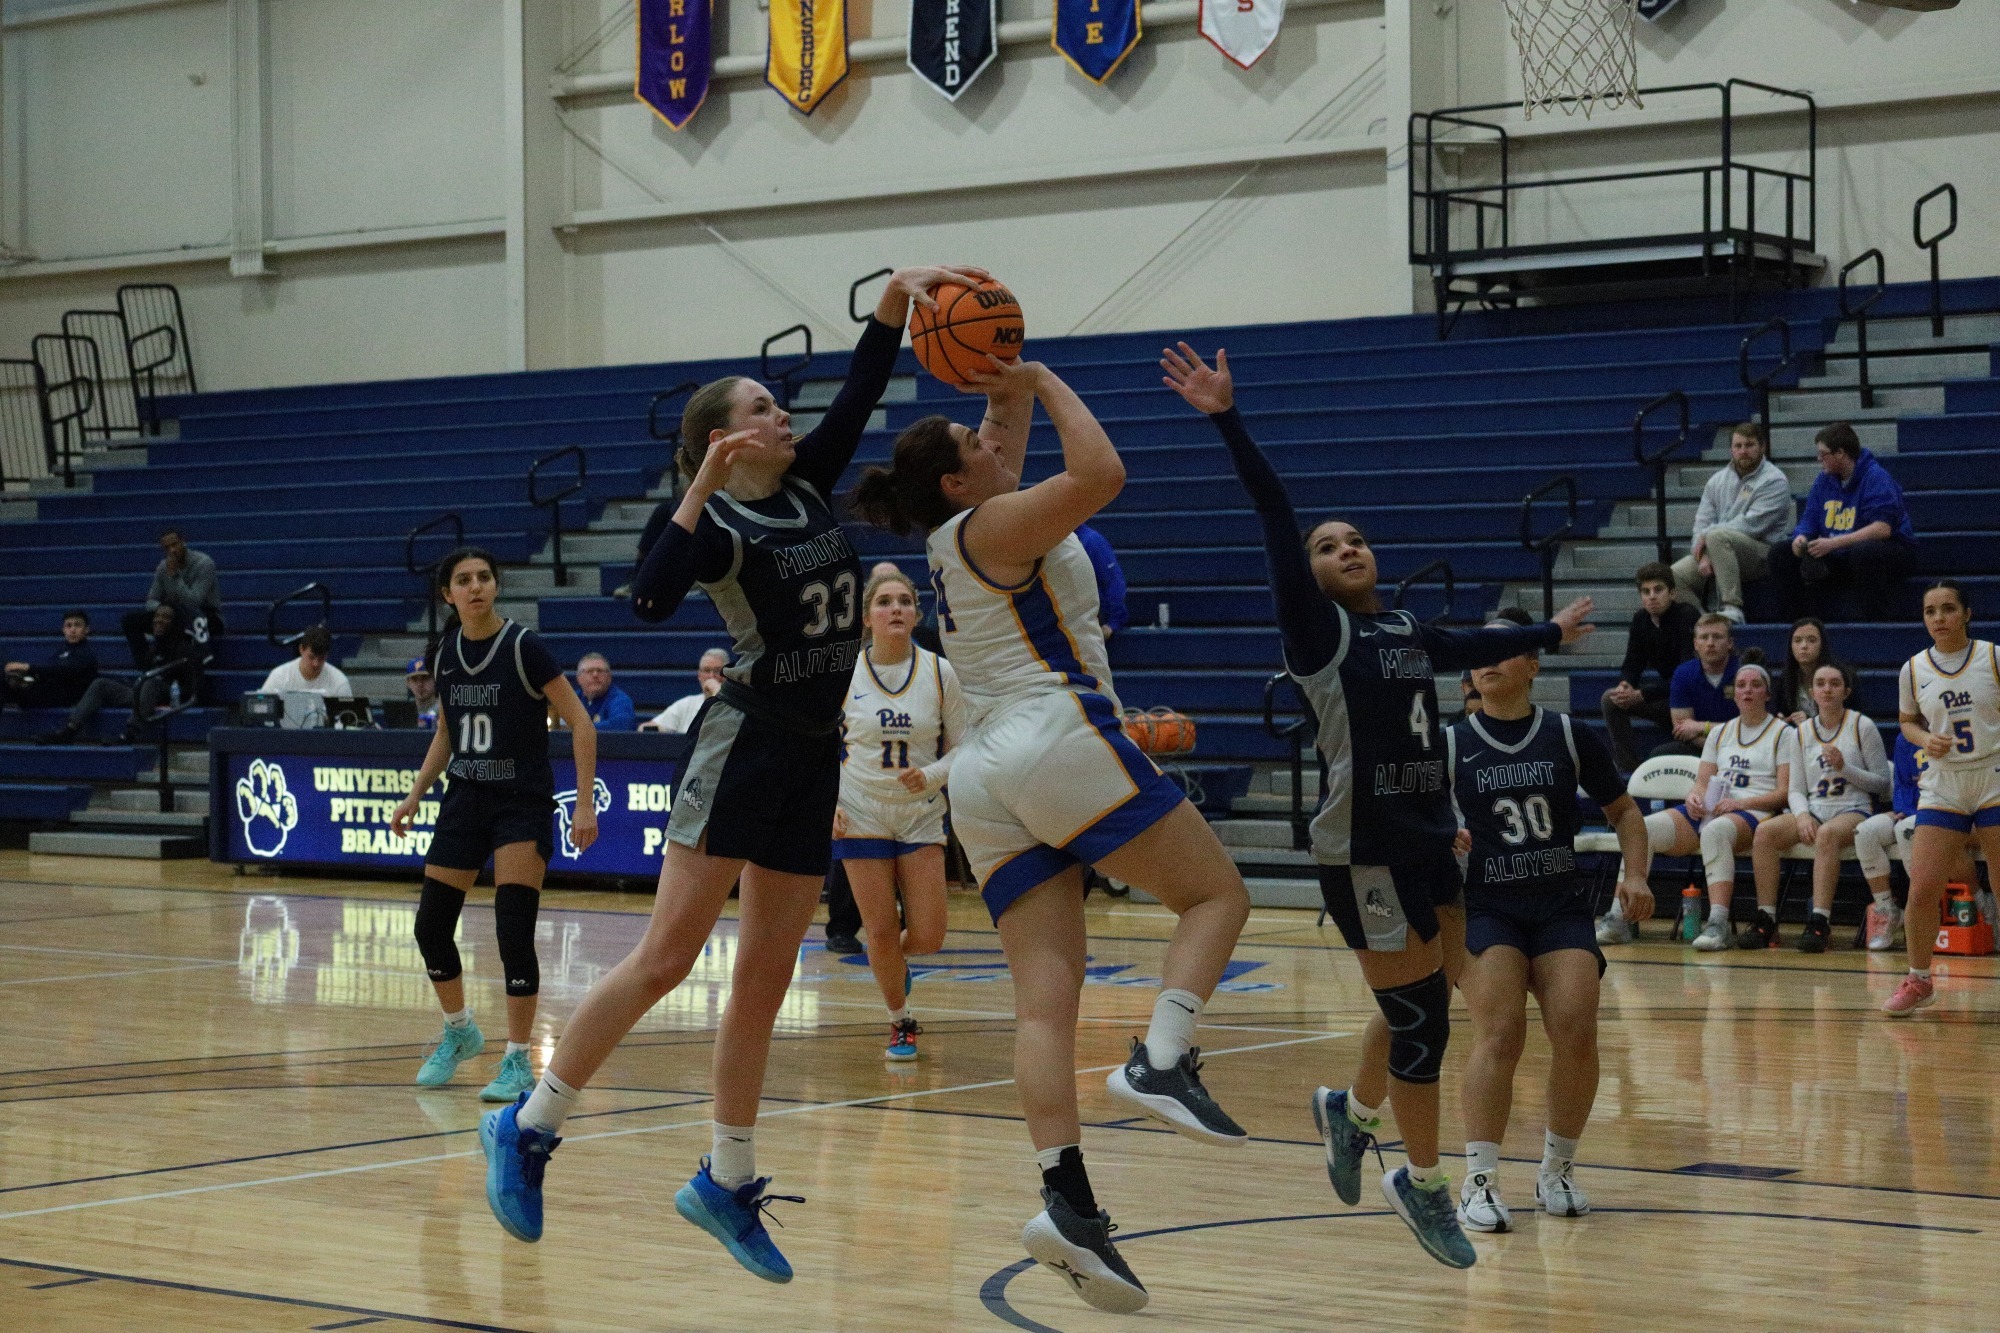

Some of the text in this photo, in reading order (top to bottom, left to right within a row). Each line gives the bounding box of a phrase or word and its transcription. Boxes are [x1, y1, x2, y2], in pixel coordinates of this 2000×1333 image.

[800, 570, 857, 638] 33
[450, 684, 500, 706] MOUNT
[1939, 691, 1972, 709] Pitt
[459, 713, 492, 753] 10
[876, 709, 912, 727] Pitt
[1409, 690, 1431, 750] 4
[1953, 719, 1975, 753] 5
[881, 740, 909, 768] 11
[1477, 762, 1554, 793] MOUNT
[1492, 794, 1553, 846] 30
[341, 828, 434, 857] BRADFO
[1484, 846, 1575, 883] ALOYSIUS
[1958, 910, 1969, 922] G
